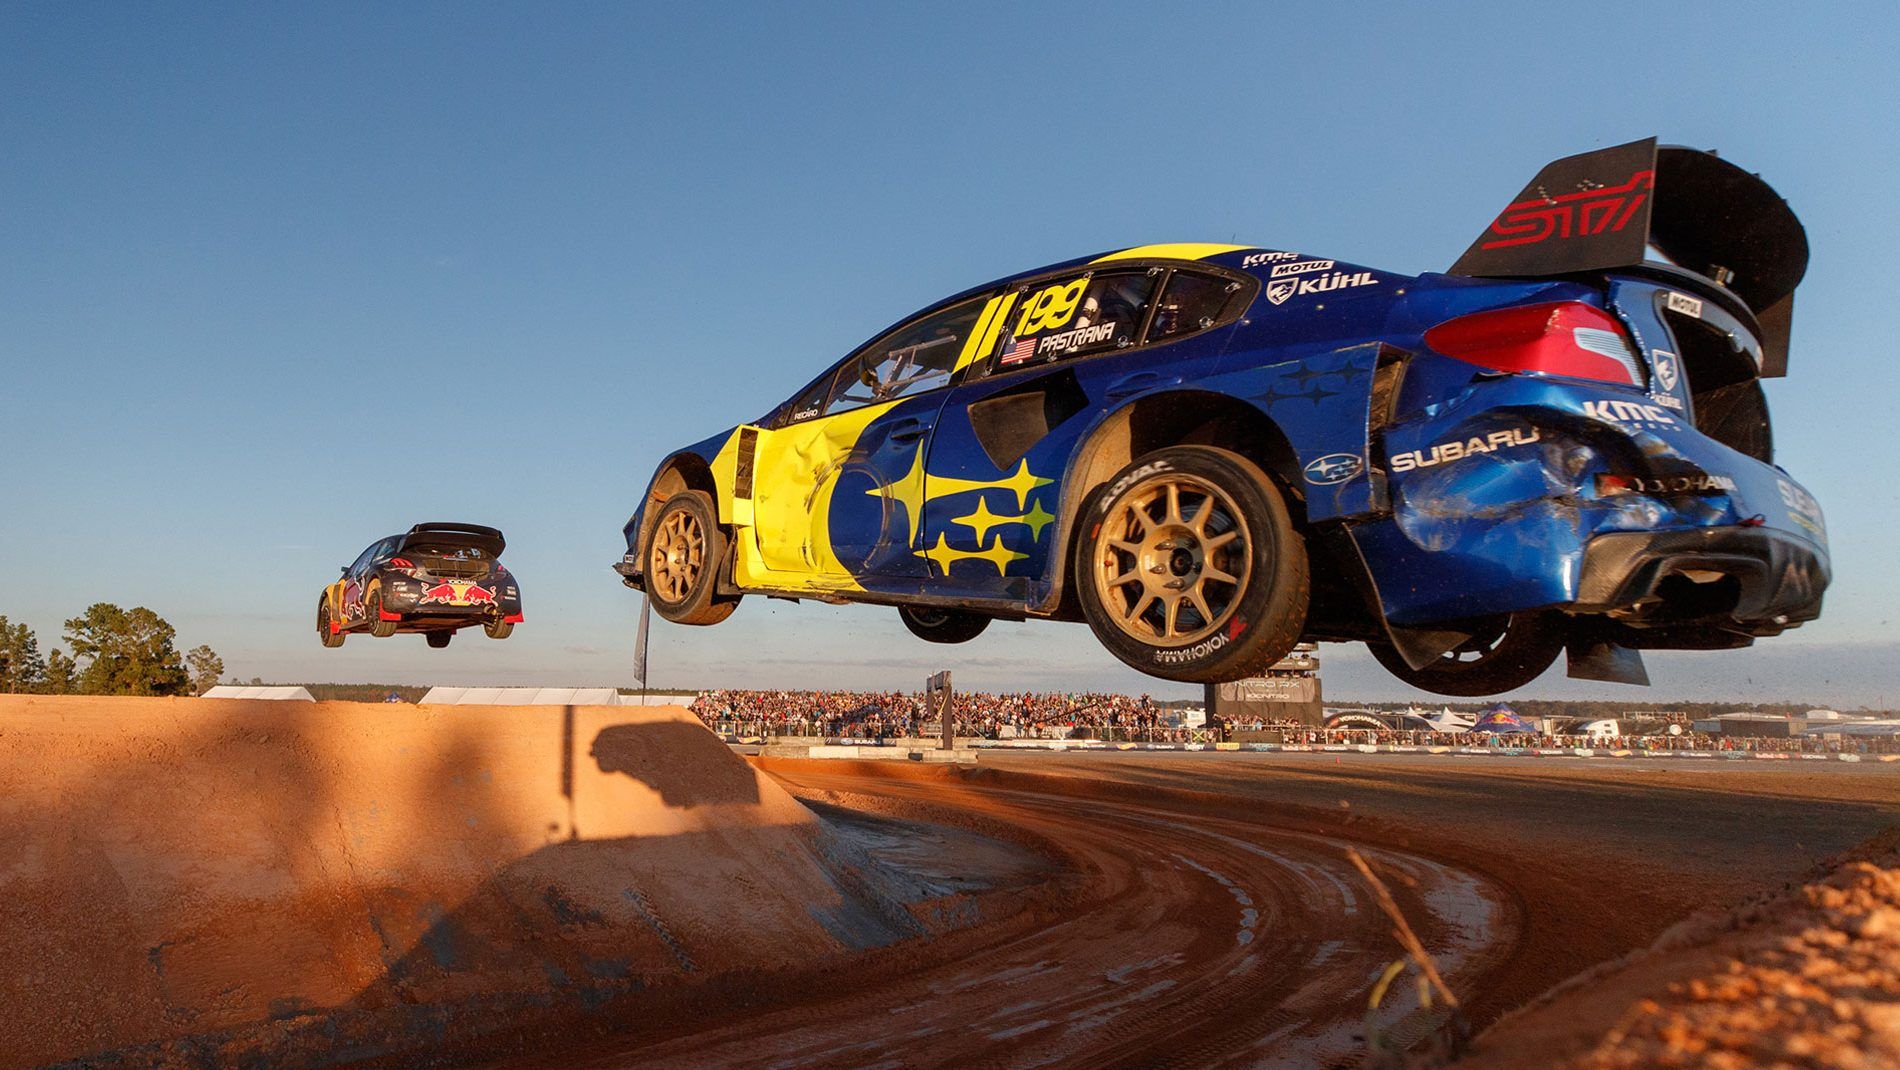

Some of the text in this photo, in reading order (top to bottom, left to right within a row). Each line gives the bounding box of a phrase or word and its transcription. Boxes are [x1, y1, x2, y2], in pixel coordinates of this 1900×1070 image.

[1275, 260, 1330, 275] MOTUL
[1297, 271, 1379, 295] KÜHL
[1013, 277, 1091, 337] 199
[1037, 321, 1116, 354] PASTRANA
[794, 408, 819, 420] RECARO
[1390, 425, 1541, 473] SUBARU
[1153, 632, 1230, 663] YOKOHAMA
[1234, 680, 1300, 688] NITRO RX
[1338, 715, 1381, 727] YOKOHAMA
